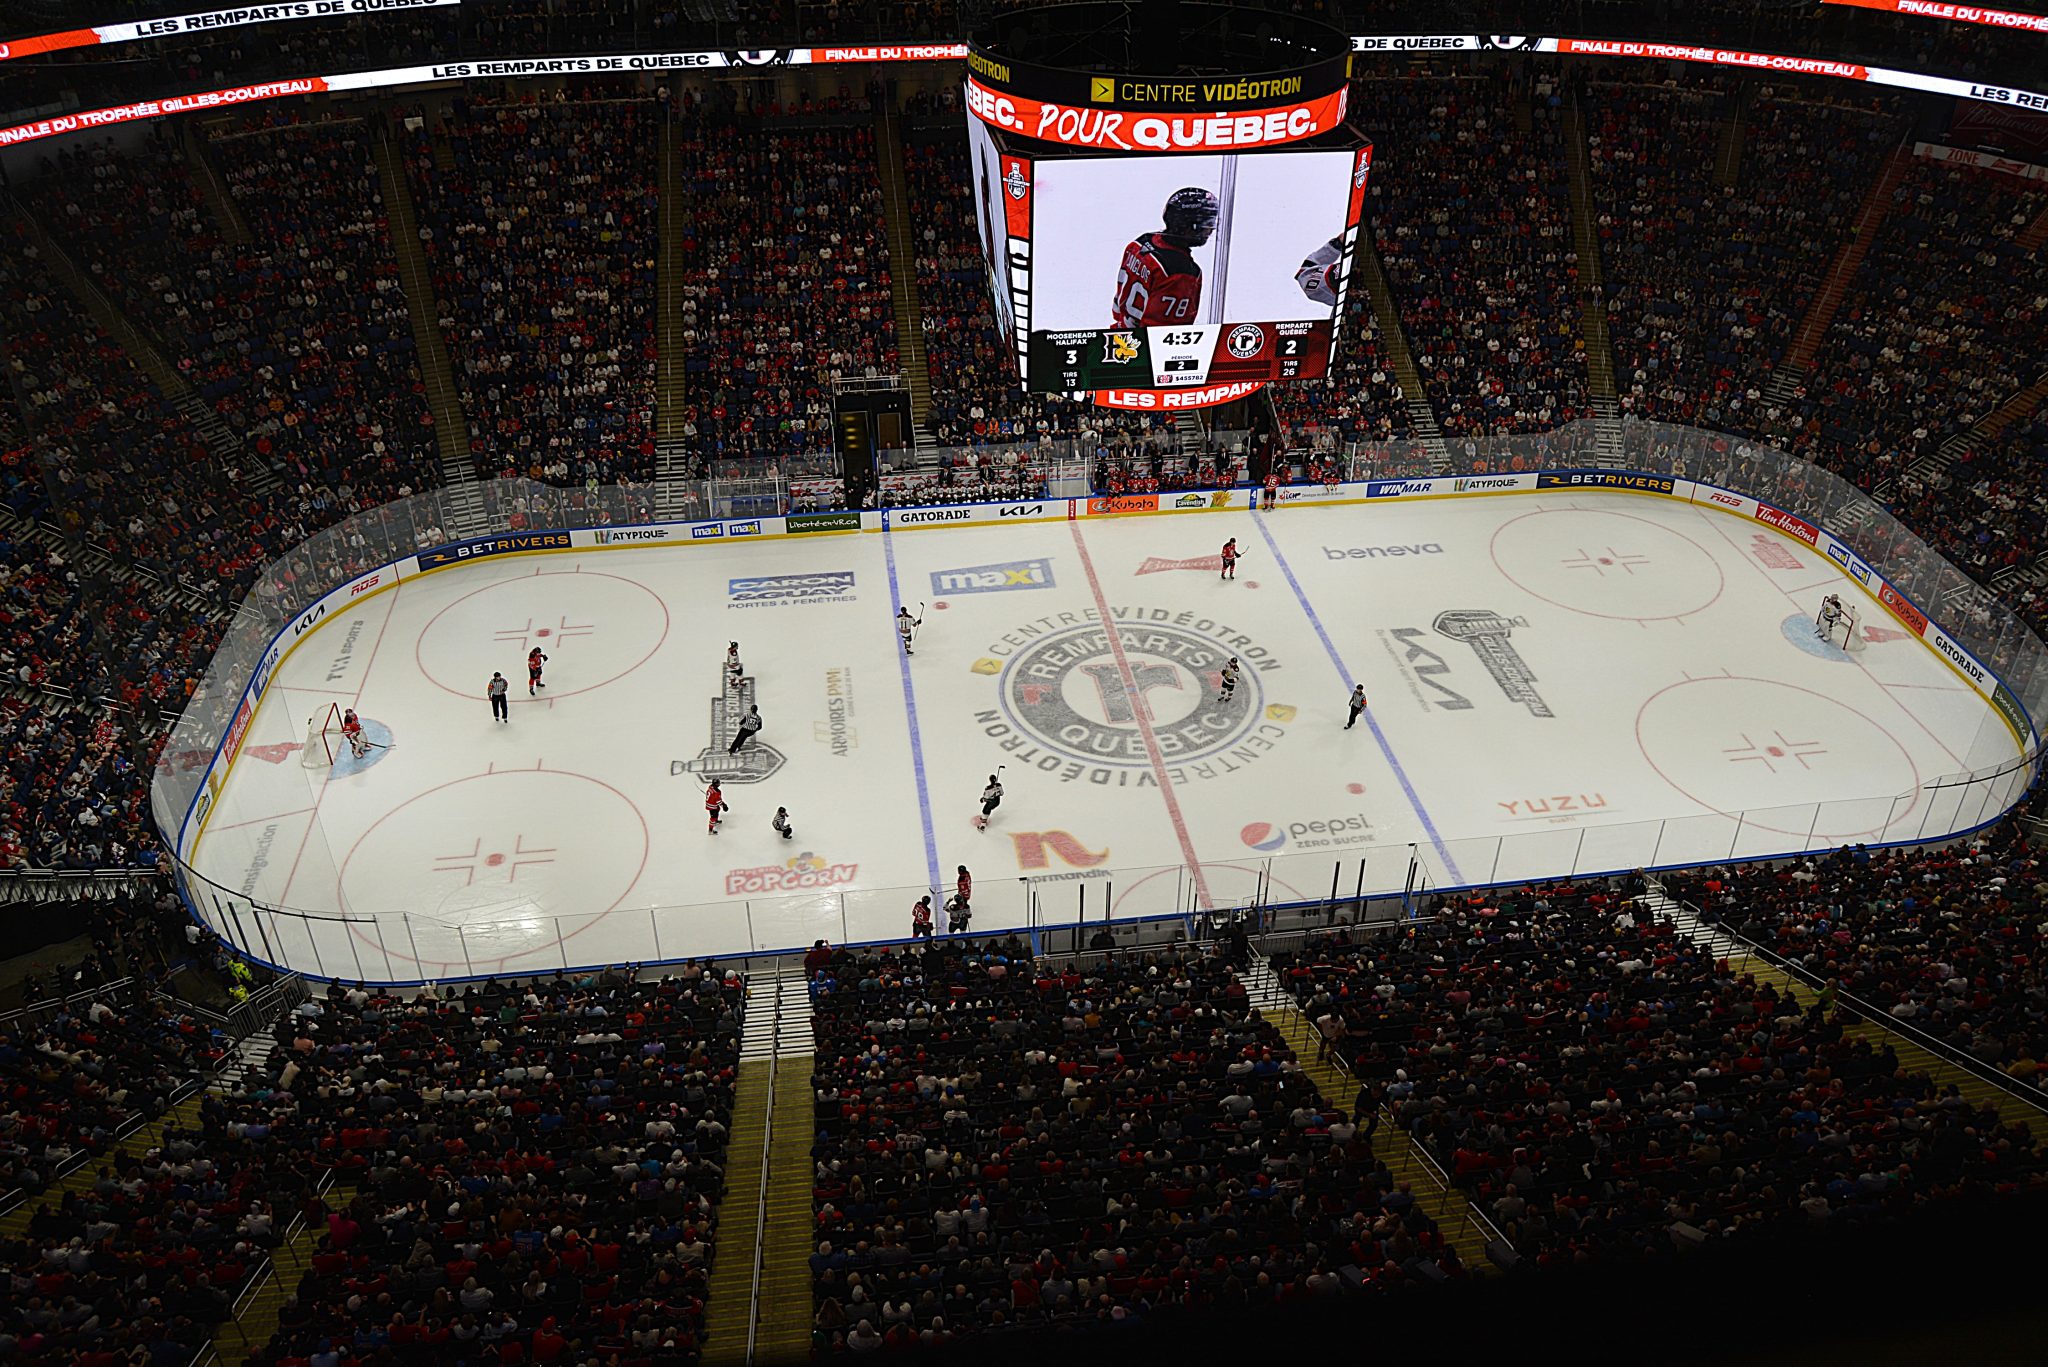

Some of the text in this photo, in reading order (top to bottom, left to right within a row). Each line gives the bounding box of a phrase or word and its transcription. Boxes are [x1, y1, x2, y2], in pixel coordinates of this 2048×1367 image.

[1897, 0, 1955, 18] FINALE
[1956, 8, 1981, 21] DU
[136, 21, 179, 37] LES
[184, 3, 309, 30] REMPARTS
[316, 1, 345, 14] DE
[1364, 38, 1388, 49] DE
[825, 44, 968, 60] FINALE DU TROPHÉ
[1570, 41, 1621, 53] FINALE
[1623, 43, 1644, 55] DU
[1646, 45, 1714, 61] TROPHÉE
[1716, 51, 1856, 77] GILLES-COURTEAU
[432, 64, 471, 78] LES
[477, 59, 591, 76] REMPARTS
[597, 58, 623, 70] DE
[1122, 76, 1302, 103] CENTRE VIDÉOTRON
[1970, 85, 2010, 101] LES
[53, 116, 77, 132] DU
[77, 102, 159, 126] TROPHÉE
[162, 80, 313, 112] GILLES-COURTEAU
[1037, 103, 1317, 151] POUR QUÉBEC.
[1946, 149, 1980, 165] ZONE
[1162, 296, 1189, 317] 78
[1230, 324, 1262, 341] REMPARTS
[1275, 322, 1313, 331] REMPARTS
[1279, 328, 1308, 336] QUÉBEC
[1046, 331, 1097, 341] MOOSEHEADS
[1055, 338, 1088, 346] HALIFAX
[1162, 331, 1204, 346] 4:37
[1232, 346, 1260, 359] QUÉBEC
[1285, 340, 1297, 355] 2
[1065, 350, 1078, 365] 3
[1177, 361, 1185, 370] 2
[1283, 360, 1298, 368] TIRS
[1062, 371, 1078, 379] TIRS
[1175, 374, 1204, 382] $455782
[1282, 367, 1295, 377] 26
[1065, 378, 1076, 388] 13
[1108, 391, 1157, 407] LES
[1268, 478, 1277, 487] 15
[1379, 482, 1432, 495] WINMAR
[1469, 478, 1518, 489] ATYPIQUE
[1571, 474, 1671, 491] BETRIVERS
[1251, 490, 1257, 499] 4
[1710, 492, 1742, 507] RDS
[1000, 505, 1043, 516] KIA
[1111, 499, 1154, 510] Kubota
[1176, 499, 1206, 507] Cavendish
[882, 511, 889, 521] 4
[901, 510, 970, 522] GATORADE
[695, 525, 722, 537] maxi
[732, 522, 760, 535] maxi
[1758, 504, 1815, 545] Tim Hortons
[613, 528, 669, 542] ATYPIQUE
[458, 534, 569, 557] BETRIVERS
[1322, 542, 1444, 561] beneva
[1829, 545, 1849, 564] maxi
[1145, 557, 1220, 570] Budweise
[941, 562, 1045, 590] maxi
[1852, 562, 1870, 584] maxi
[351, 575, 380, 596] RDS
[731, 576, 851, 590] CARON
[727, 600, 777, 609] PORTES
[793, 594, 857, 604] FENÊTRES
[295, 604, 325, 636] KIA
[1895, 598, 1924, 630] Kubota
[341, 620, 364, 652] SPORTS
[988, 605, 1282, 672] CENTRE VIDÉOTRON
[1028, 631, 1215, 679] REMPARTS
[1935, 635, 1985, 684] GATORADE
[257, 648, 279, 690] WINMAR
[1481, 635, 1548, 716] GILLES-COURTEAU
[828, 697, 848, 757] ARMOIRES
[1059, 712, 1232, 755] QUÉBEC
[225, 710, 251, 762] Tim Hortons
[974, 709, 1285, 787] VIDÉOTRON CENTRE
[1498, 793, 1607, 815] YUZU
[1290, 813, 1370, 839] pepsi
[1296, 834, 1376, 848] ZERO SUCRE
